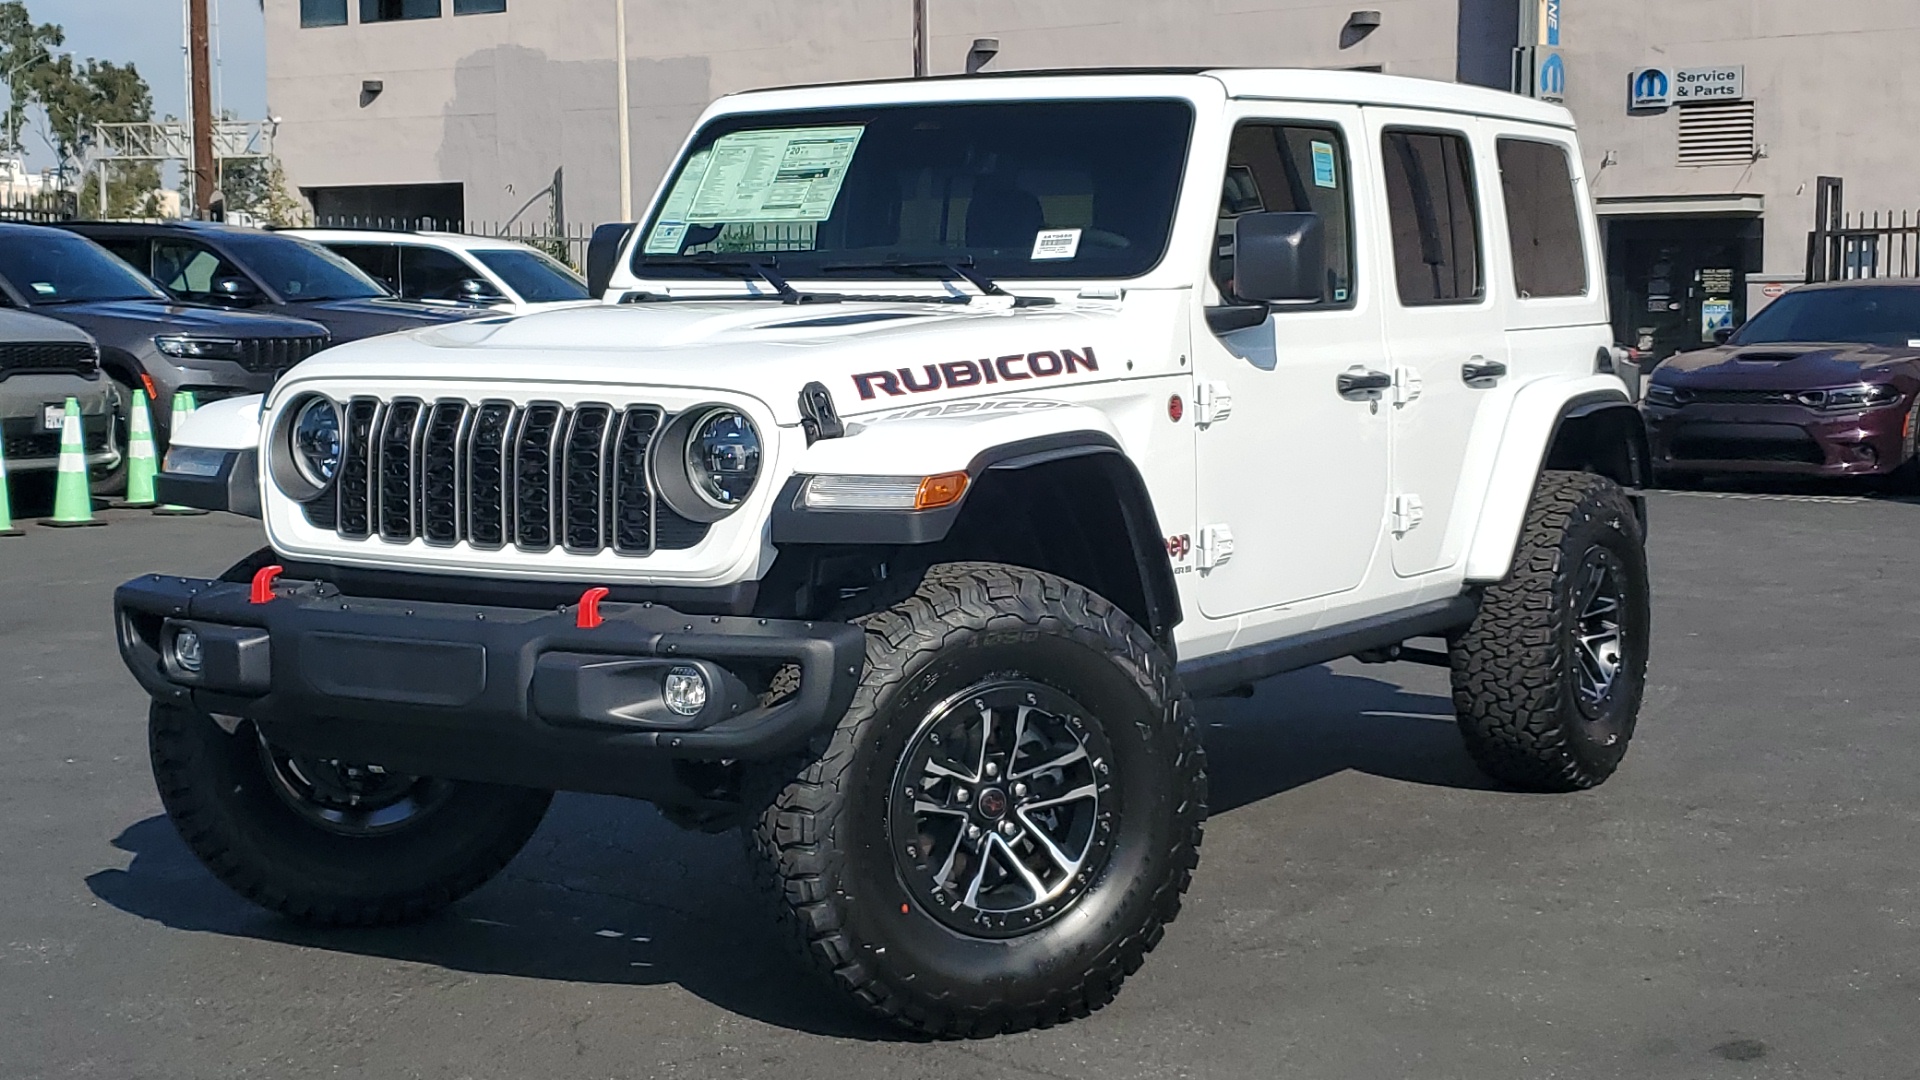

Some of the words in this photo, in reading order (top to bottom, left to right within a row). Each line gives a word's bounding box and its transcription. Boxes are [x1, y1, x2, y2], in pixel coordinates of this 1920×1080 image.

[1676, 70, 1736, 83] Service
[1676, 86, 1689, 97] &
[1694, 85, 1735, 97] Parts
[851, 346, 1099, 401] RUBICON
